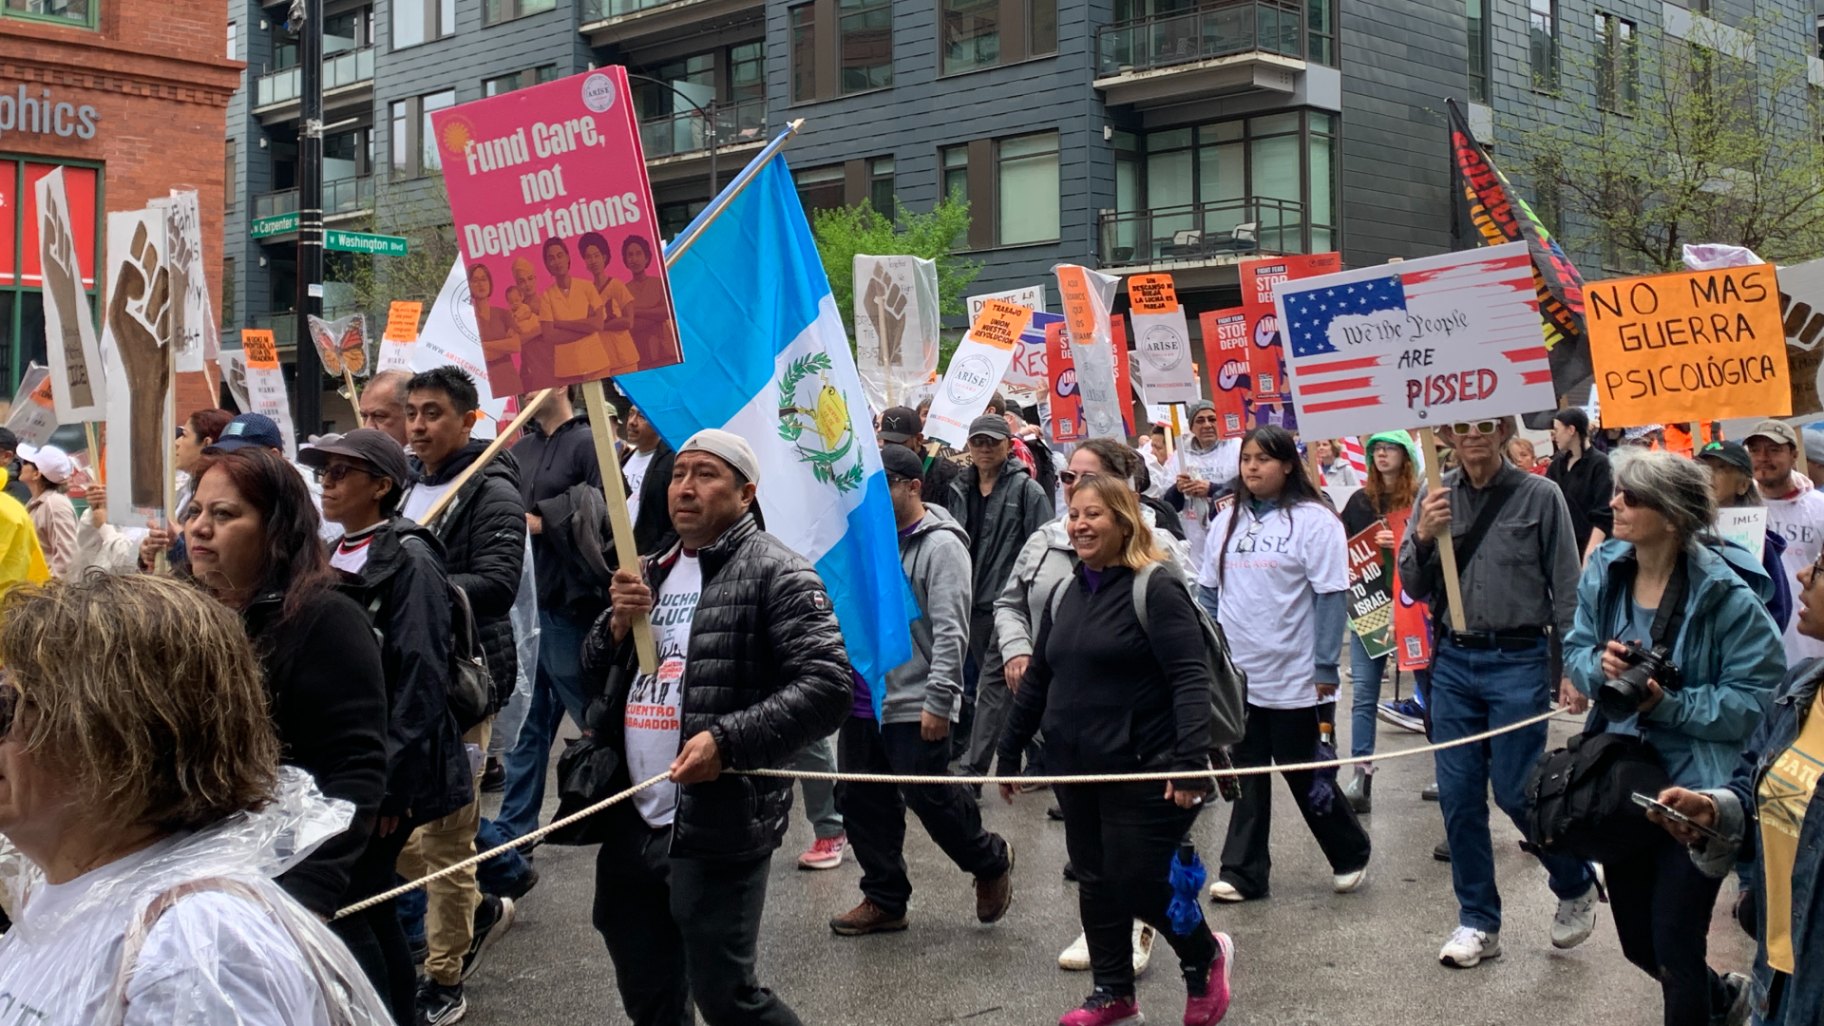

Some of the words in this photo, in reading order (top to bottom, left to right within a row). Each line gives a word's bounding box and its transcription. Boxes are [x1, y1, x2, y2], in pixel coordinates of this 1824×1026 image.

[464, 127, 530, 176] Fund
[531, 115, 606, 159] Care,
[520, 163, 567, 204] not
[259, 217, 293, 234] Carpenter
[463, 192, 641, 259] Deportations
[338, 233, 388, 252] Washington
[390, 242, 404, 252] Blvd
[1590, 282, 1659, 321] NO
[1689, 272, 1768, 308] MAS
[992, 304, 1022, 317] TRABAJO
[982, 324, 1012, 337] NUESTRA
[990, 318, 1011, 328] UNION
[1376, 318, 1402, 341] the
[1405, 308, 1471, 342] People
[1618, 313, 1757, 352] GUERRA
[974, 330, 1014, 344] REVOLUCION
[1147, 341, 1179, 352] ARISE
[1397, 348, 1436, 370] ARE
[955, 369, 988, 388] ARISE
[1406, 368, 1499, 409] PISSED
[1605, 354, 1777, 400] PSICOLÓGICA
[1732, 513, 1760, 526] IMLS
[1766, 520, 1815, 545] ISE
[1350, 539, 1377, 568] ALL
[1360, 561, 1382, 585] AID
[1351, 583, 1367, 600] TO
[1353, 589, 1392, 618] ISRAEL
